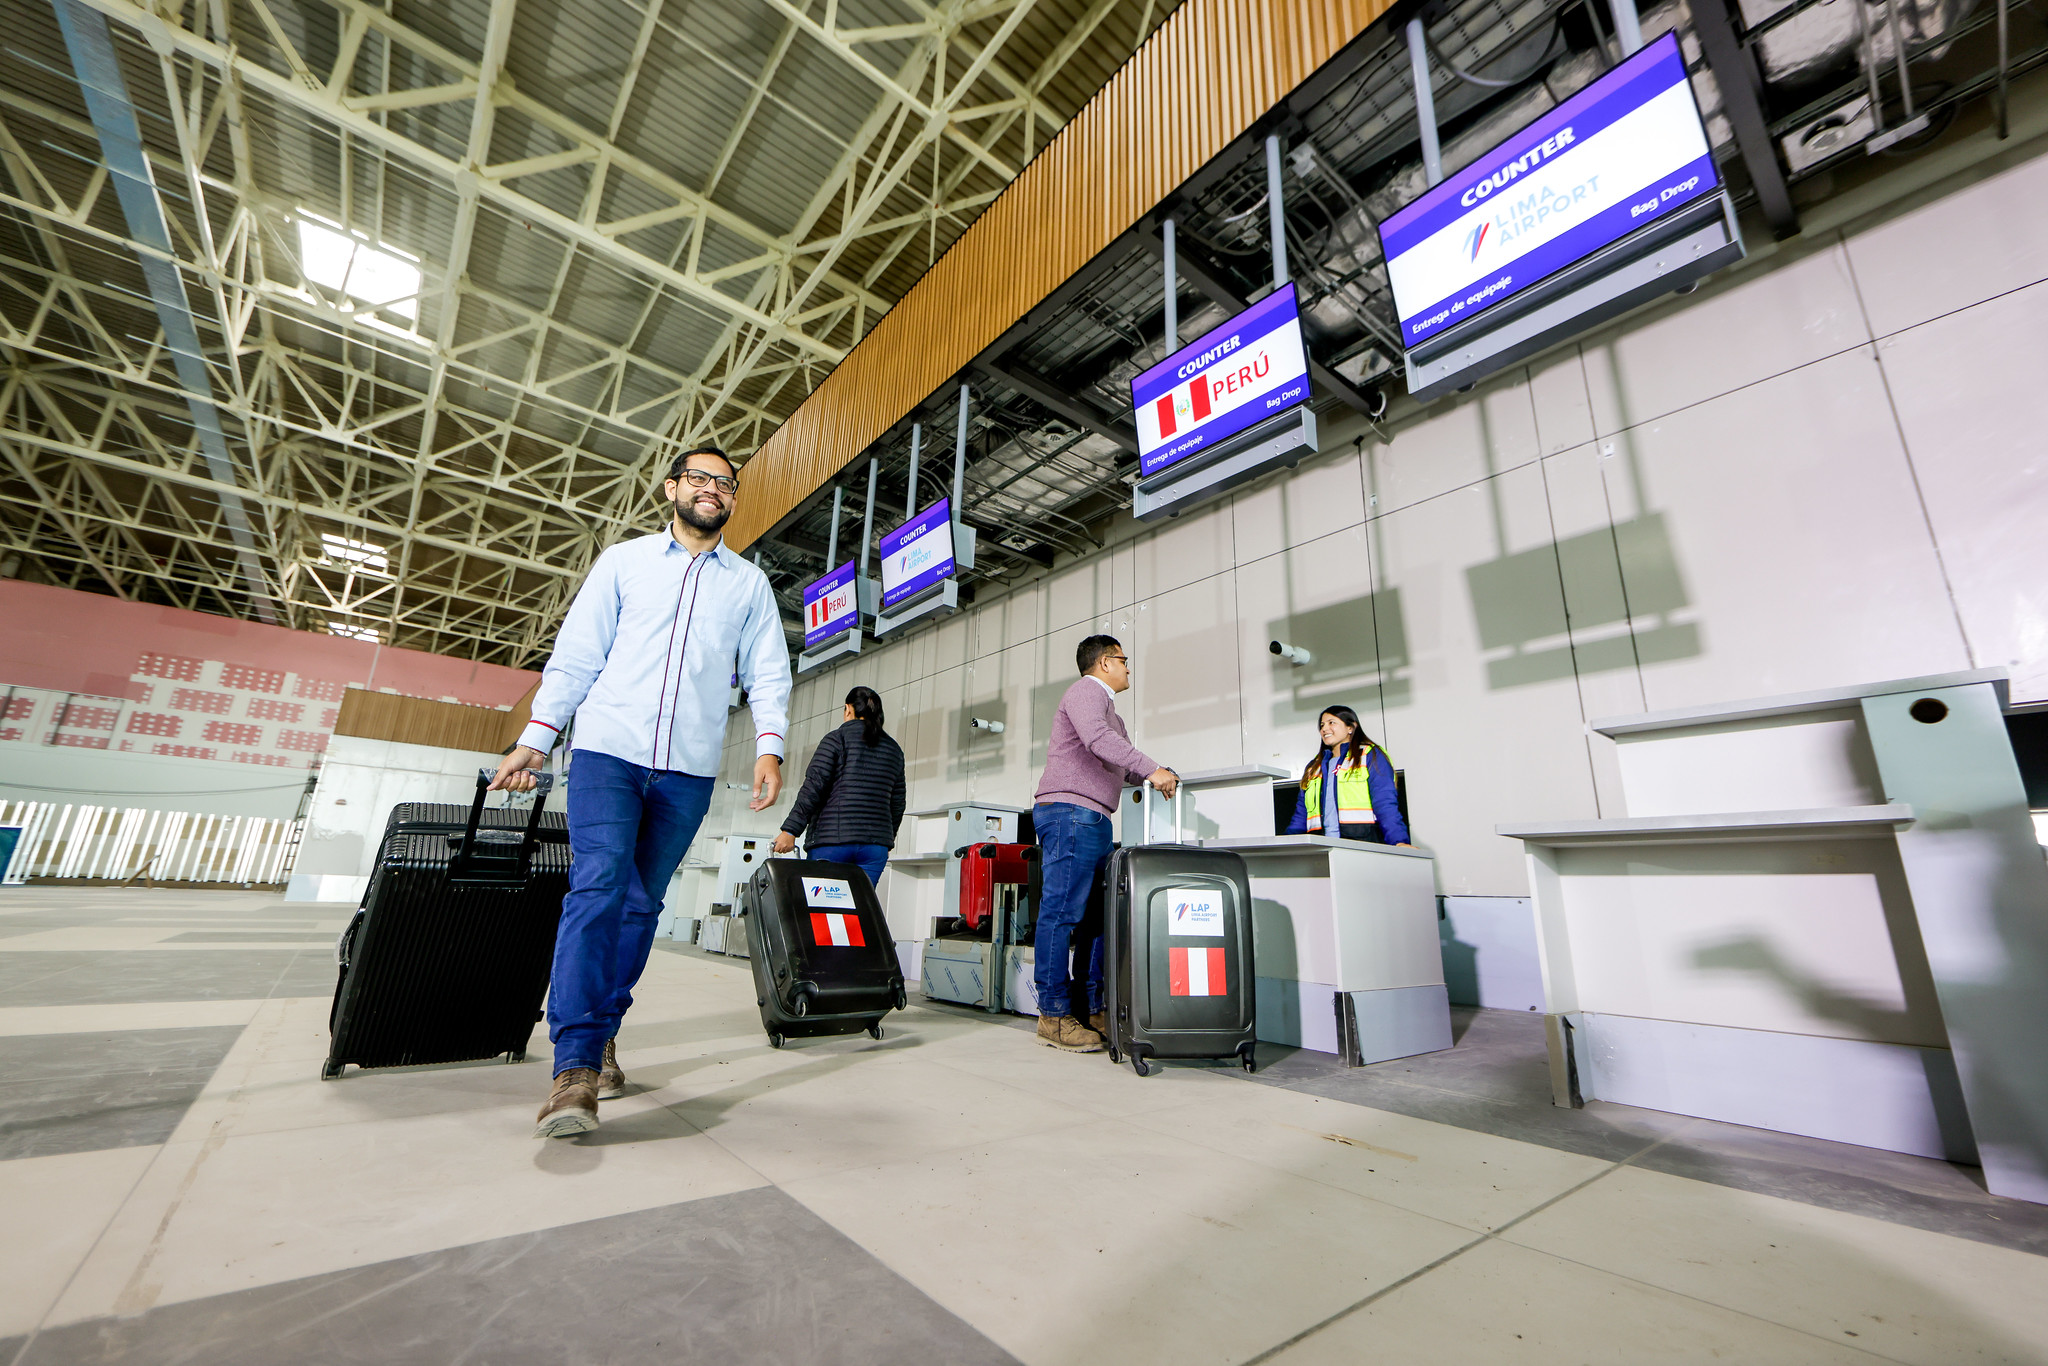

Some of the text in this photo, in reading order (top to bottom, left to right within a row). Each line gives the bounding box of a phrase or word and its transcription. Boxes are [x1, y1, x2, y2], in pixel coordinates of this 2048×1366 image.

[1461, 126, 1576, 207] COUNTER
[1496, 186, 1555, 228] LIMA
[1499, 175, 1600, 246] AIRPORT
[1630, 176, 1699, 218] Bag Drop
[1412, 275, 1512, 334] Entrega de equipaje
[1178, 335, 1241, 378] COUNTER
[1213, 351, 1270, 401] PERÚ
[1266, 386, 1301, 409] Bag Drop
[1147, 435, 1203, 467] Entrega de equipaje
[900, 523, 927, 545] COUNTER
[908, 547, 921, 561] LIMA
[908, 550, 932, 570] AIRPORT
[818, 579, 839, 596] COUNTER
[829, 592, 847, 613] PERÚ
[1191, 903, 1210, 912] LAP
